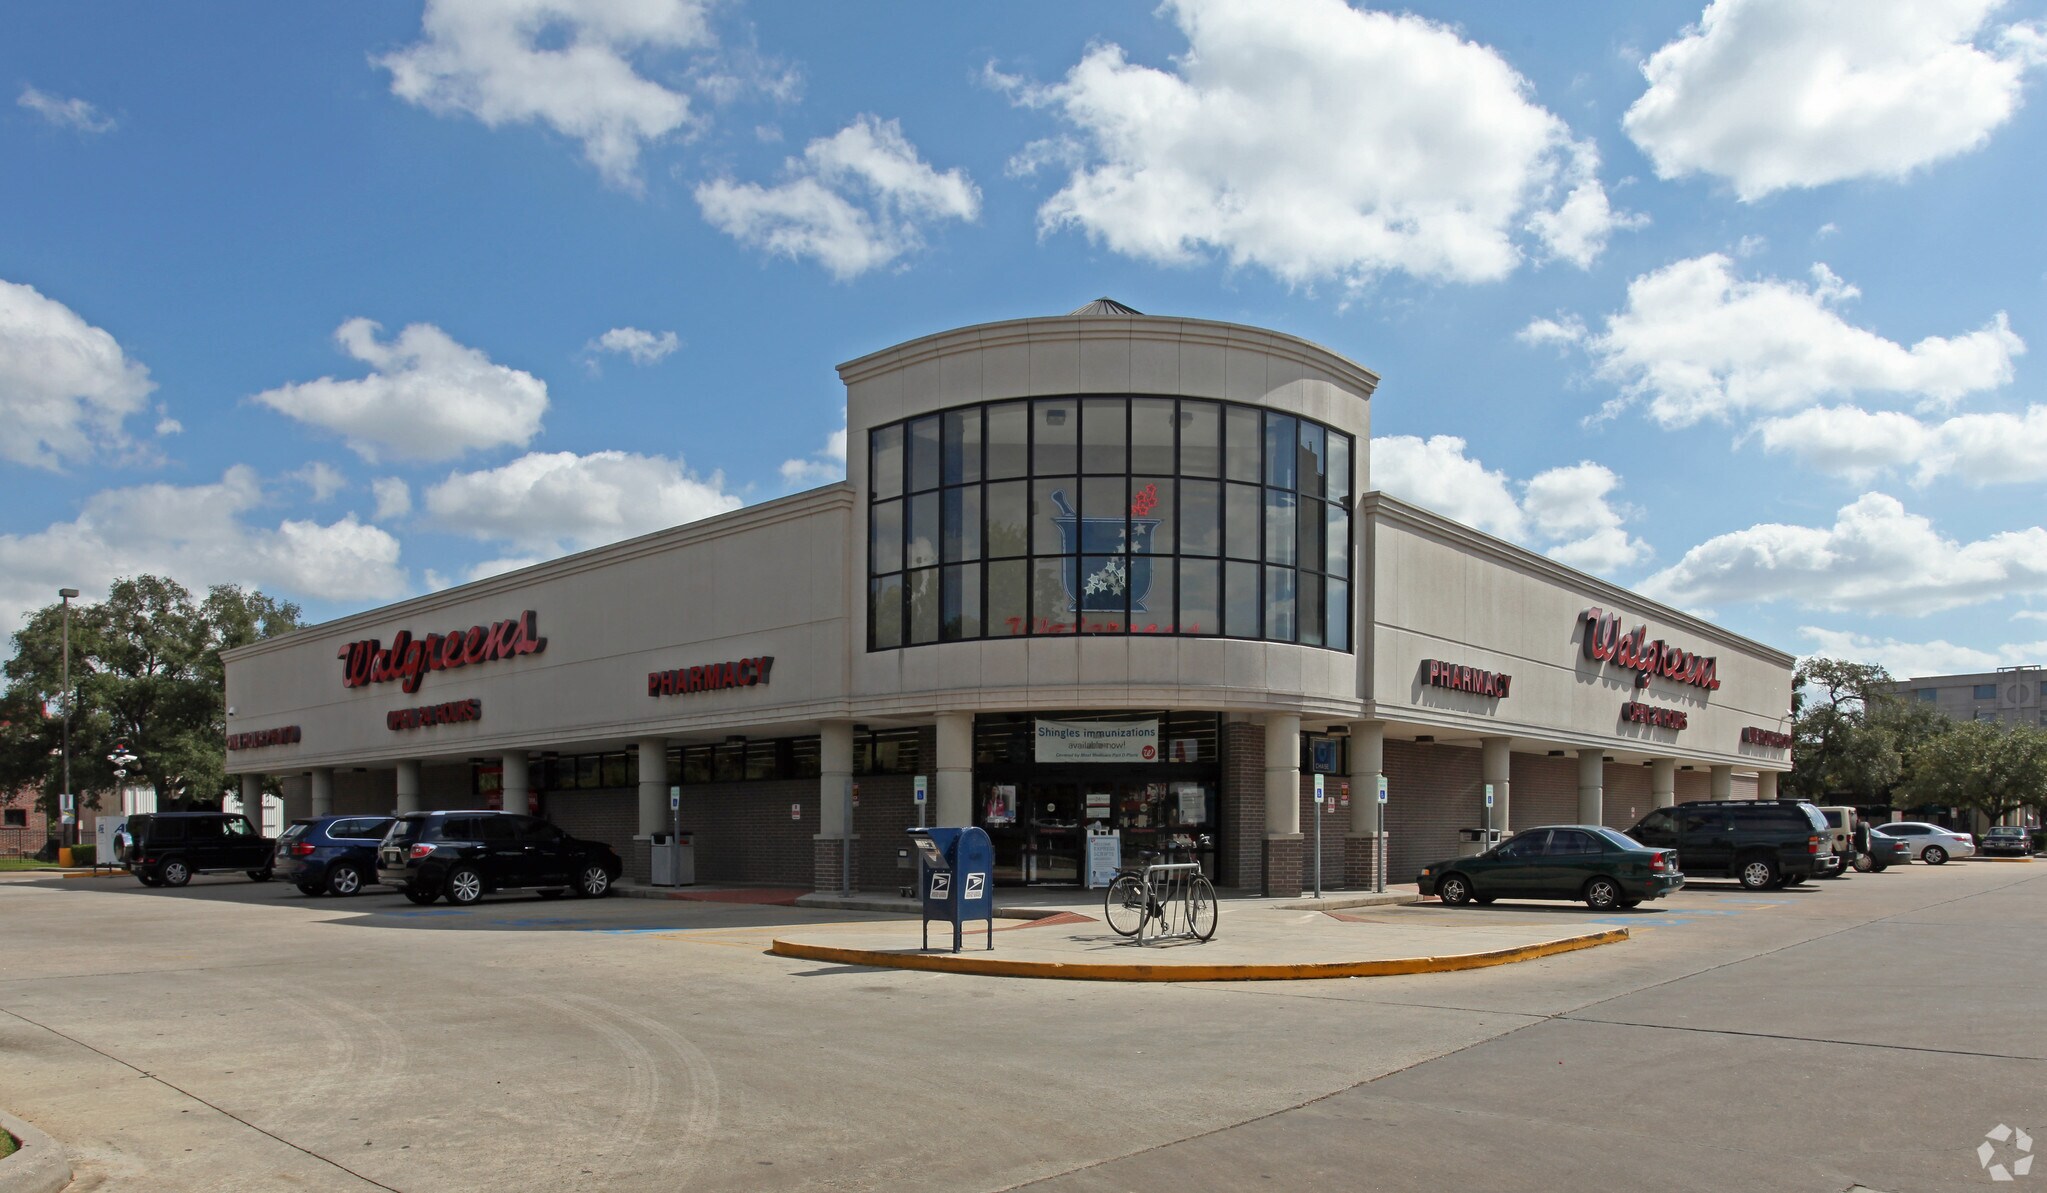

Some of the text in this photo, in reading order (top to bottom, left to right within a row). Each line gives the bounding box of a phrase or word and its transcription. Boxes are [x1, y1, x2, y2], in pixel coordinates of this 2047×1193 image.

[338, 610, 547, 693] Walgreens
[1578, 607, 1721, 690] Walgreens
[648, 656, 774, 697] PHARMACY
[1421, 659, 1512, 698] PHARMACY
[387, 699, 481, 731] OPEN 24 HOURS
[1038, 727, 1155, 739] Shingles immunizations
[1622, 701, 1649, 726] OPEN
[1650, 706, 1665, 727] 24
